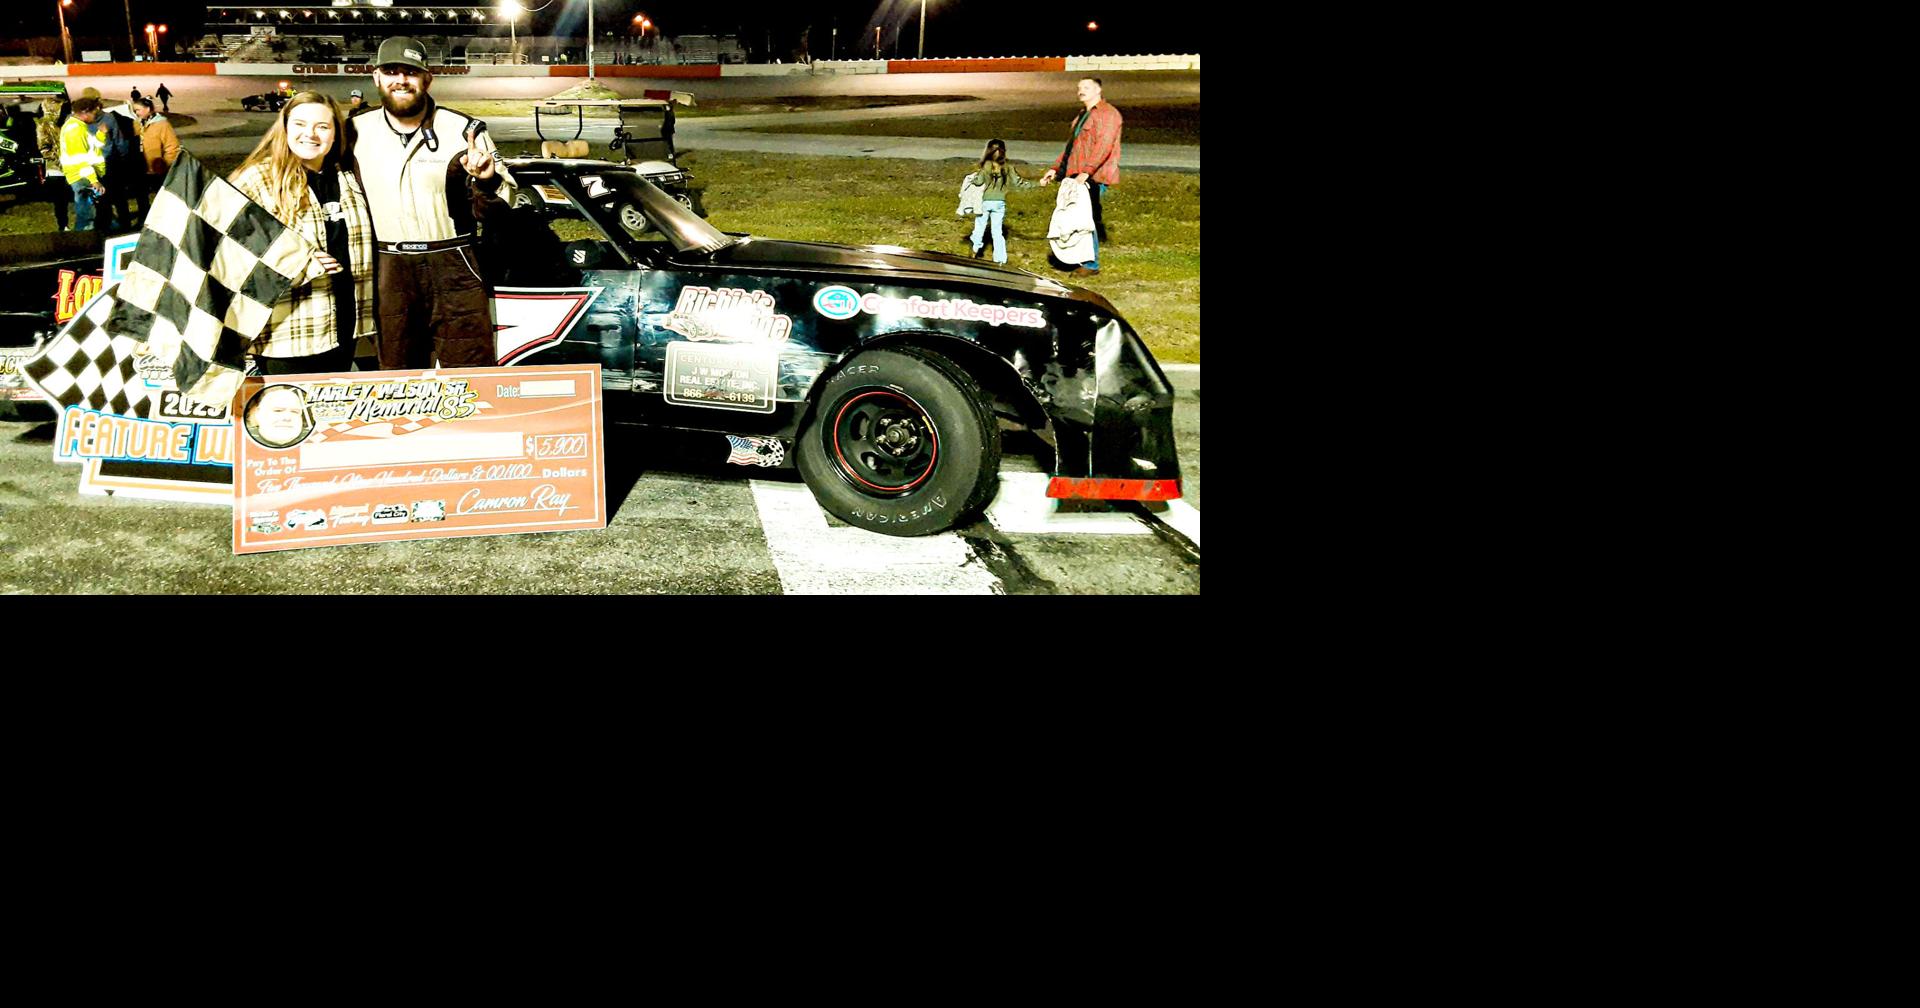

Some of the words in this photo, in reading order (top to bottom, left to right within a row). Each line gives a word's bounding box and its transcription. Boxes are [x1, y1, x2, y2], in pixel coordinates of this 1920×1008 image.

[344, 64, 376, 74] COUN
[863, 296, 948, 316] Cfort
[953, 301, 1038, 325] Keepers
[680, 375, 702, 385] REAL
[711, 368, 749, 379] MOTON
[307, 383, 375, 403] HARLEY
[377, 382, 441, 401] WILSON
[496, 384, 520, 398] Date:
[683, 388, 755, 403] 866--6139
[348, 396, 441, 422] Memorial
[439, 392, 478, 420] 85
[62, 407, 191, 460] FEATURE
[247, 459, 264, 469] Pay
[267, 458, 278, 467] To
[280, 457, 297, 466] The
[254, 467, 282, 477] Order
[284, 466, 297, 475] Of
[542, 467, 588, 479] Dollars
[456, 488, 528, 516] Camron
[530, 484, 573, 517] Ray
